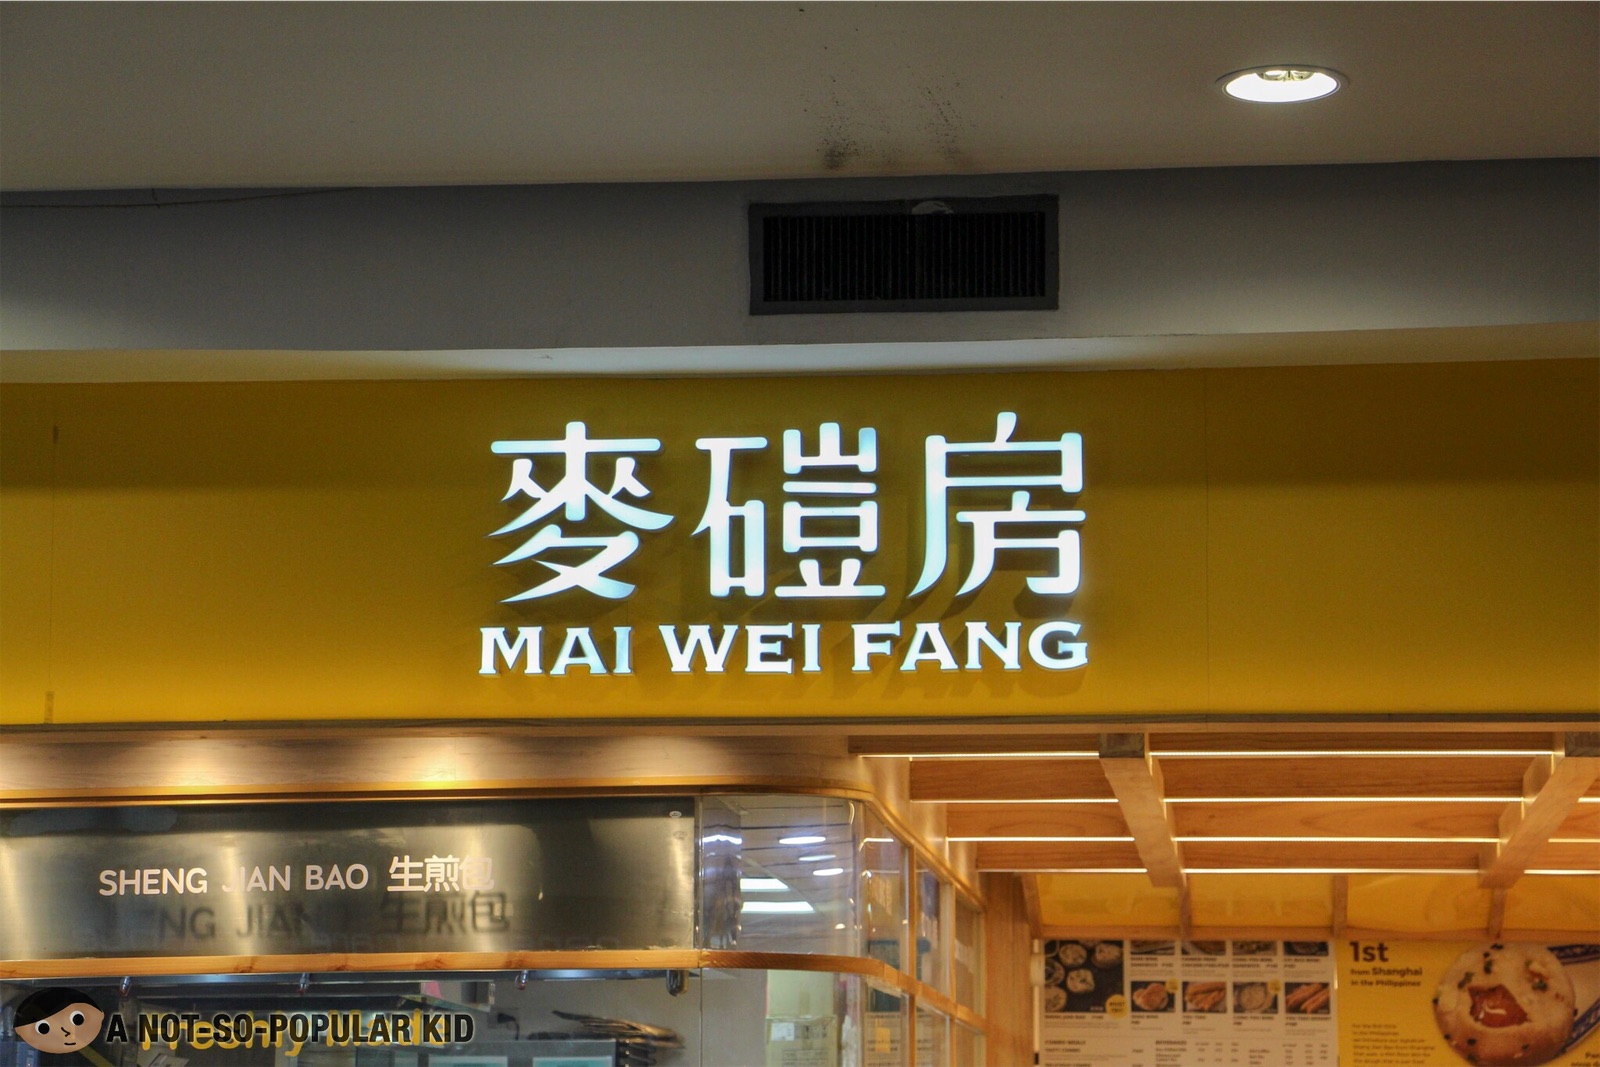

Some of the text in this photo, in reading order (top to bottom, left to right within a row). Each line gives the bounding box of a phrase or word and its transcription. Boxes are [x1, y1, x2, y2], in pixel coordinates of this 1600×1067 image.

[487, 411, 1087, 603] 麥磑房
[479, 620, 1090, 675] MAI WEI FANG
[99, 863, 369, 897] SHENG JIAN BAO
[386, 854, 495, 893] 生煎包
[1349, 940, 1390, 962] 1st
[1350, 967, 1423, 978] from Shanghai
[1375, 979, 1421, 988] Philippines
